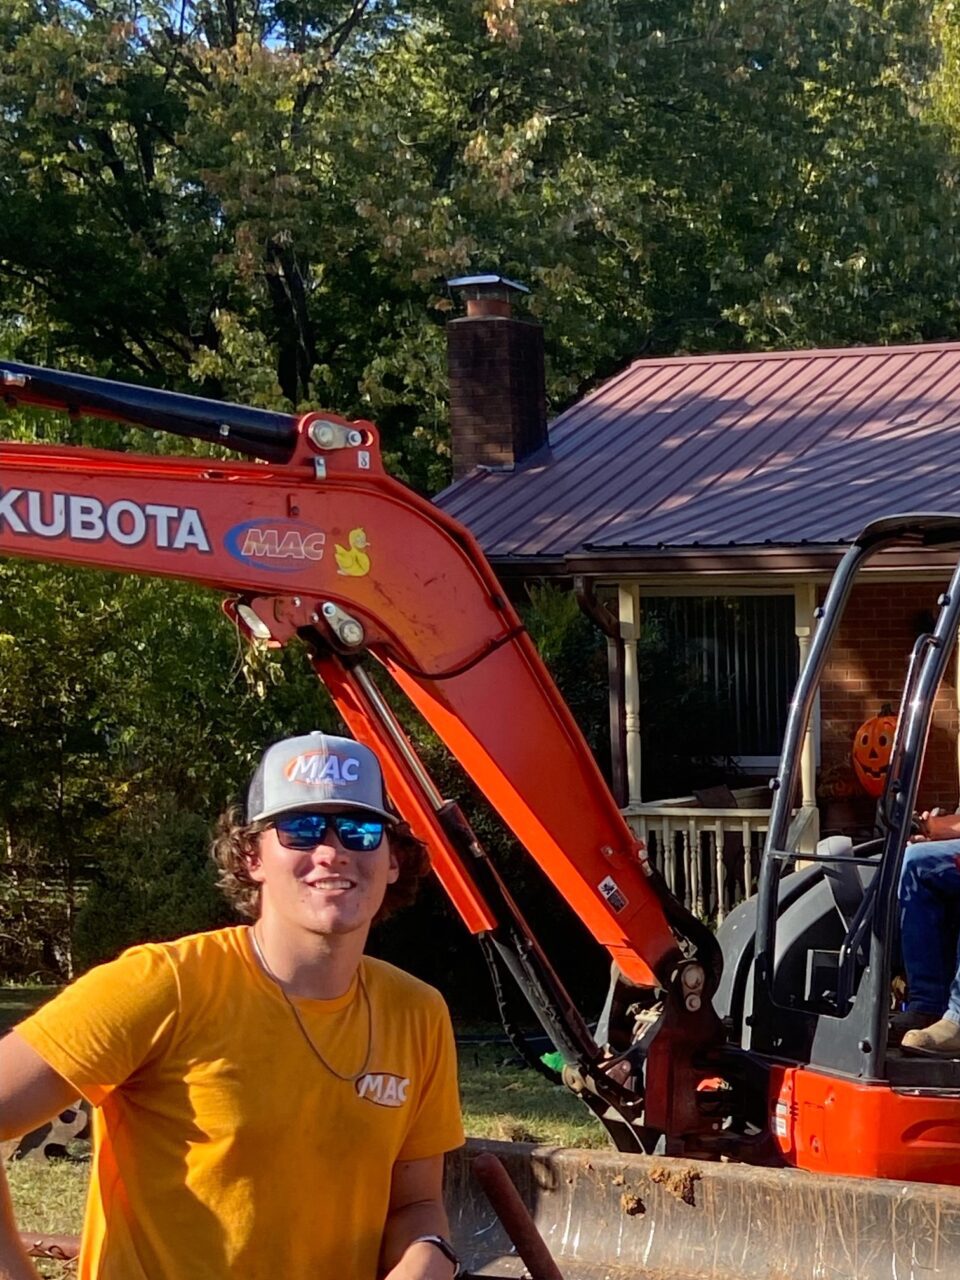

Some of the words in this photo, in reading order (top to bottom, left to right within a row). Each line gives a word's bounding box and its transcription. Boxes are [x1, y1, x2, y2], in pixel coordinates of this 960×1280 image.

[0, 489, 210, 551] KUBOTA
[241, 528, 326, 560] MAC
[288, 755, 359, 782] MAC
[359, 1074, 410, 1102] MAC
